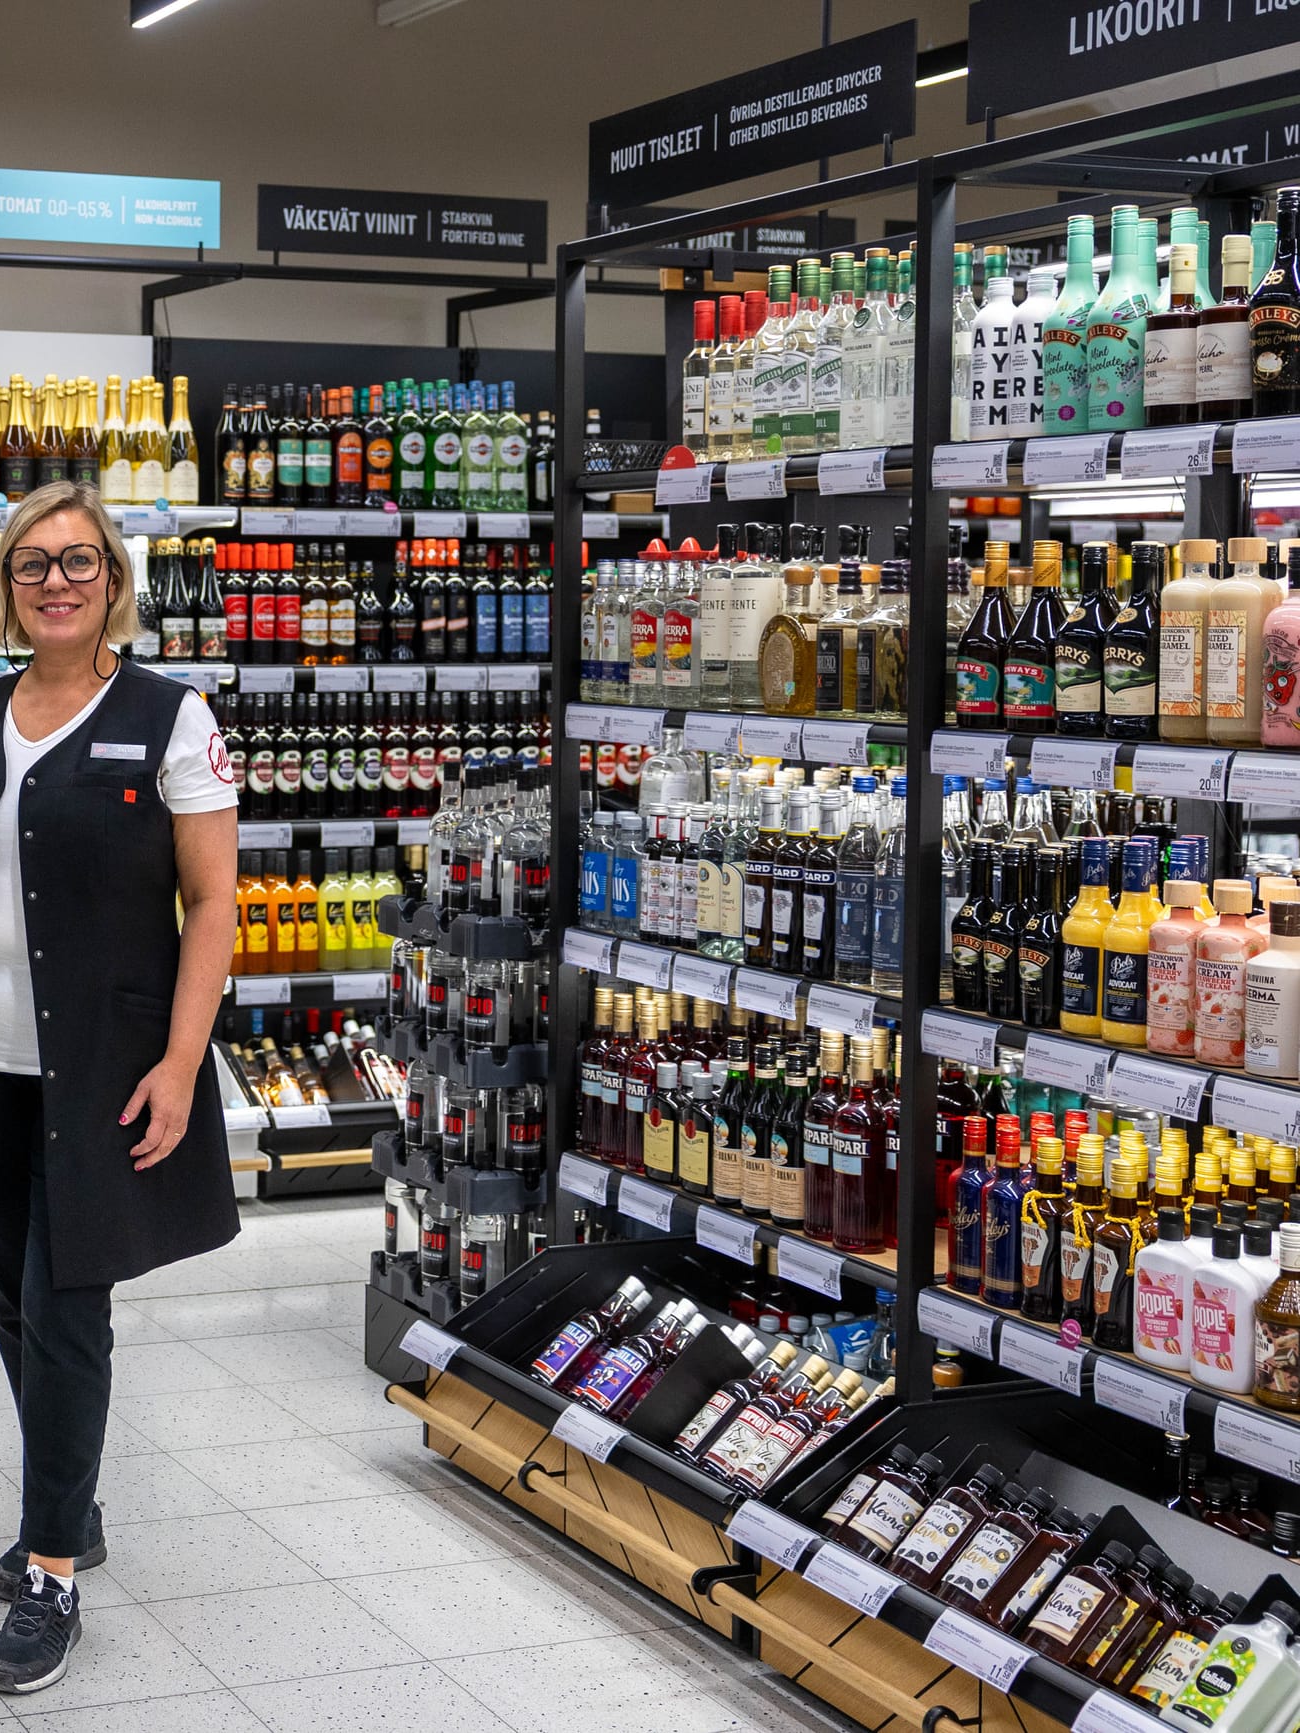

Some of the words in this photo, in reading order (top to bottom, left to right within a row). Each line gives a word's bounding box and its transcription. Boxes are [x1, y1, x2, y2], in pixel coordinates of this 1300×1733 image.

[729, 96, 763, 124] ÖVRIGA
[764, 80, 834, 116] DESTILLERADE
[835, 64, 882, 98] DRYCKER
[729, 123, 759, 147] OTHER
[760, 109, 809, 139] DISTILLED
[810, 94, 868, 129] BEVERAGES
[610, 144, 645, 174] MUUT
[648, 125, 703, 164] TISLEET
[135, 199, 198, 212] ALKOHOLFRITT
[135, 213, 203, 228] NON-ALCOHOLIC
[283, 203, 358, 233] VÄKEVÄT
[364, 212, 417, 236] VIINIT
[441, 211, 493, 227] STARKVIN
[441, 228, 496, 246] FORTIFIED
[497, 232, 525, 247] WINE
[1055, 644, 1091, 665] ERRY'S
[1104, 646, 1146, 667] ERRY'S
[1199, 778, 1212, 791] 20
[1198, 967, 1232, 979] CREAM
[1108, 979, 1138, 990] ADVOCAAT
[1207, 982, 1232, 991] CREAM
[1248, 989, 1276, 1002] ERMA
[1139, 1291, 1175, 1317] POPLE
[1194, 1305, 1227, 1331] POPLE
[865, 1495, 906, 1536] Kerma
[1065, 1582, 1087, 1597] HELMI
[1044, 1592, 1084, 1620] Kerma
